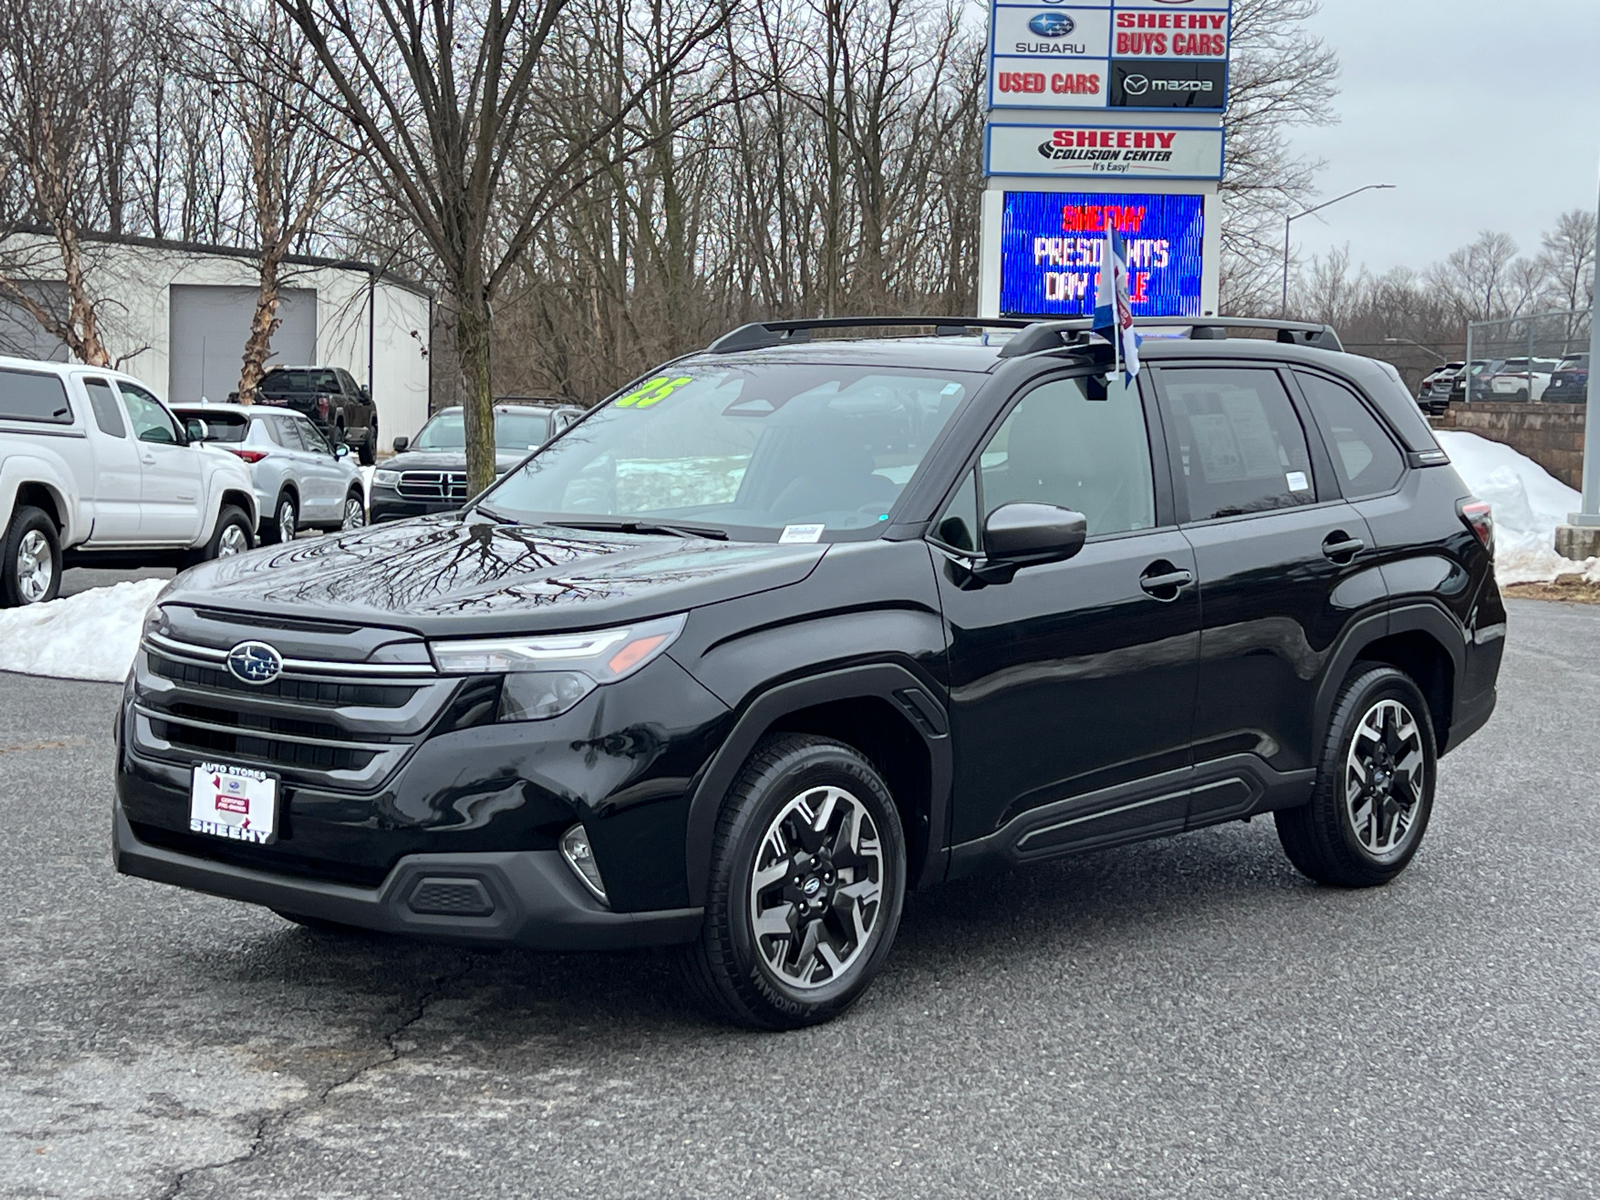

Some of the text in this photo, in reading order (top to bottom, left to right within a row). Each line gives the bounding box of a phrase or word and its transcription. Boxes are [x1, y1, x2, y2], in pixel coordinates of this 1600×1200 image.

[1116, 13, 1226, 29] SHEEHY
[1015, 43, 1085, 54] SUBARU
[1116, 32, 1225, 56] BUYS CARS
[999, 72, 1100, 95] USED CARS
[1053, 131, 1176, 148] SHEEHY
[1052, 149, 1172, 161] COLLISION CENTER
[1092, 162, 1130, 173] It's Easy!
[1034, 237, 1169, 268] PRESINTS
[1045, 272, 1089, 301] DAY
[615, 377, 692, 408] 25
[201, 762, 266, 780] AUTO STORES
[190, 819, 270, 844] SHEEHY
